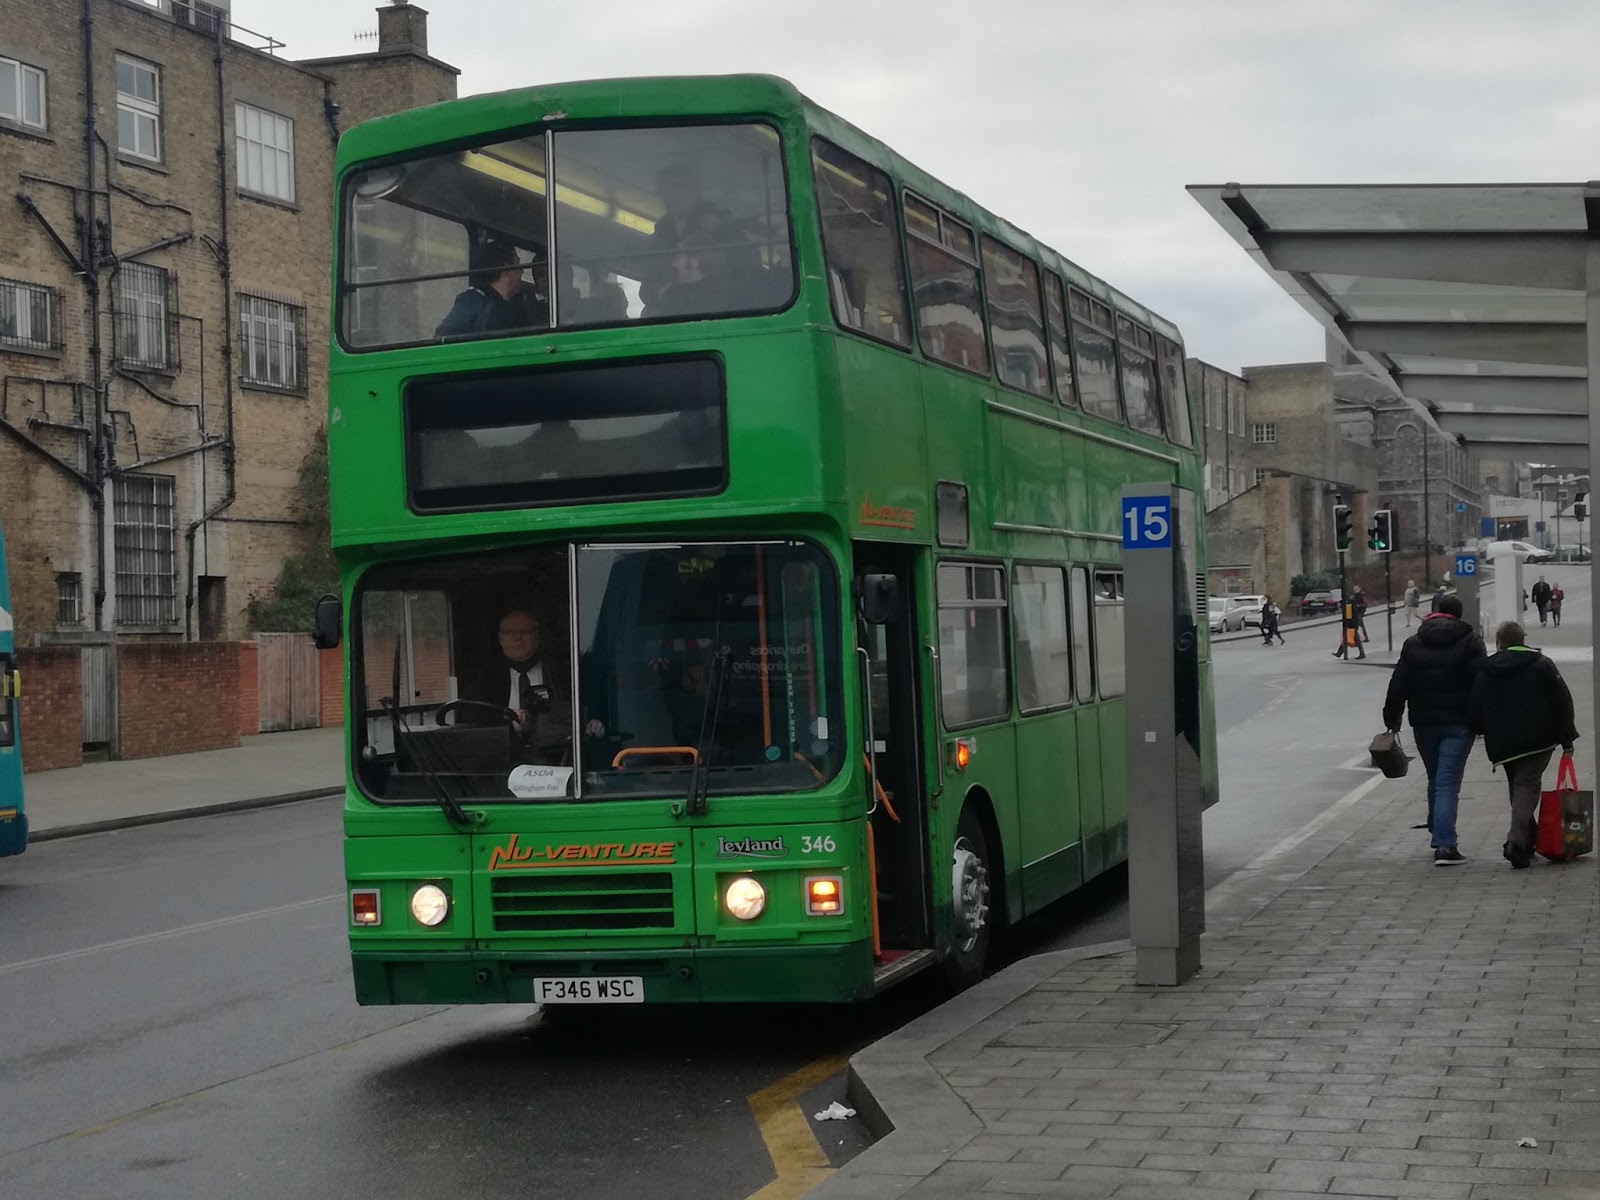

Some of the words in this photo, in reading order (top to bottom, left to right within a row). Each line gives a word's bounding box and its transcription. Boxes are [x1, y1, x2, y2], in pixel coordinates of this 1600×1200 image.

[1124, 506, 1169, 541] 15
[1456, 559, 1475, 573] 16
[524, 769, 555, 777] ASDA
[717, 836, 787, 857] Leyland
[801, 835, 836, 853] 346
[542, 980, 591, 999] F346
[597, 980, 635, 998] WSC
